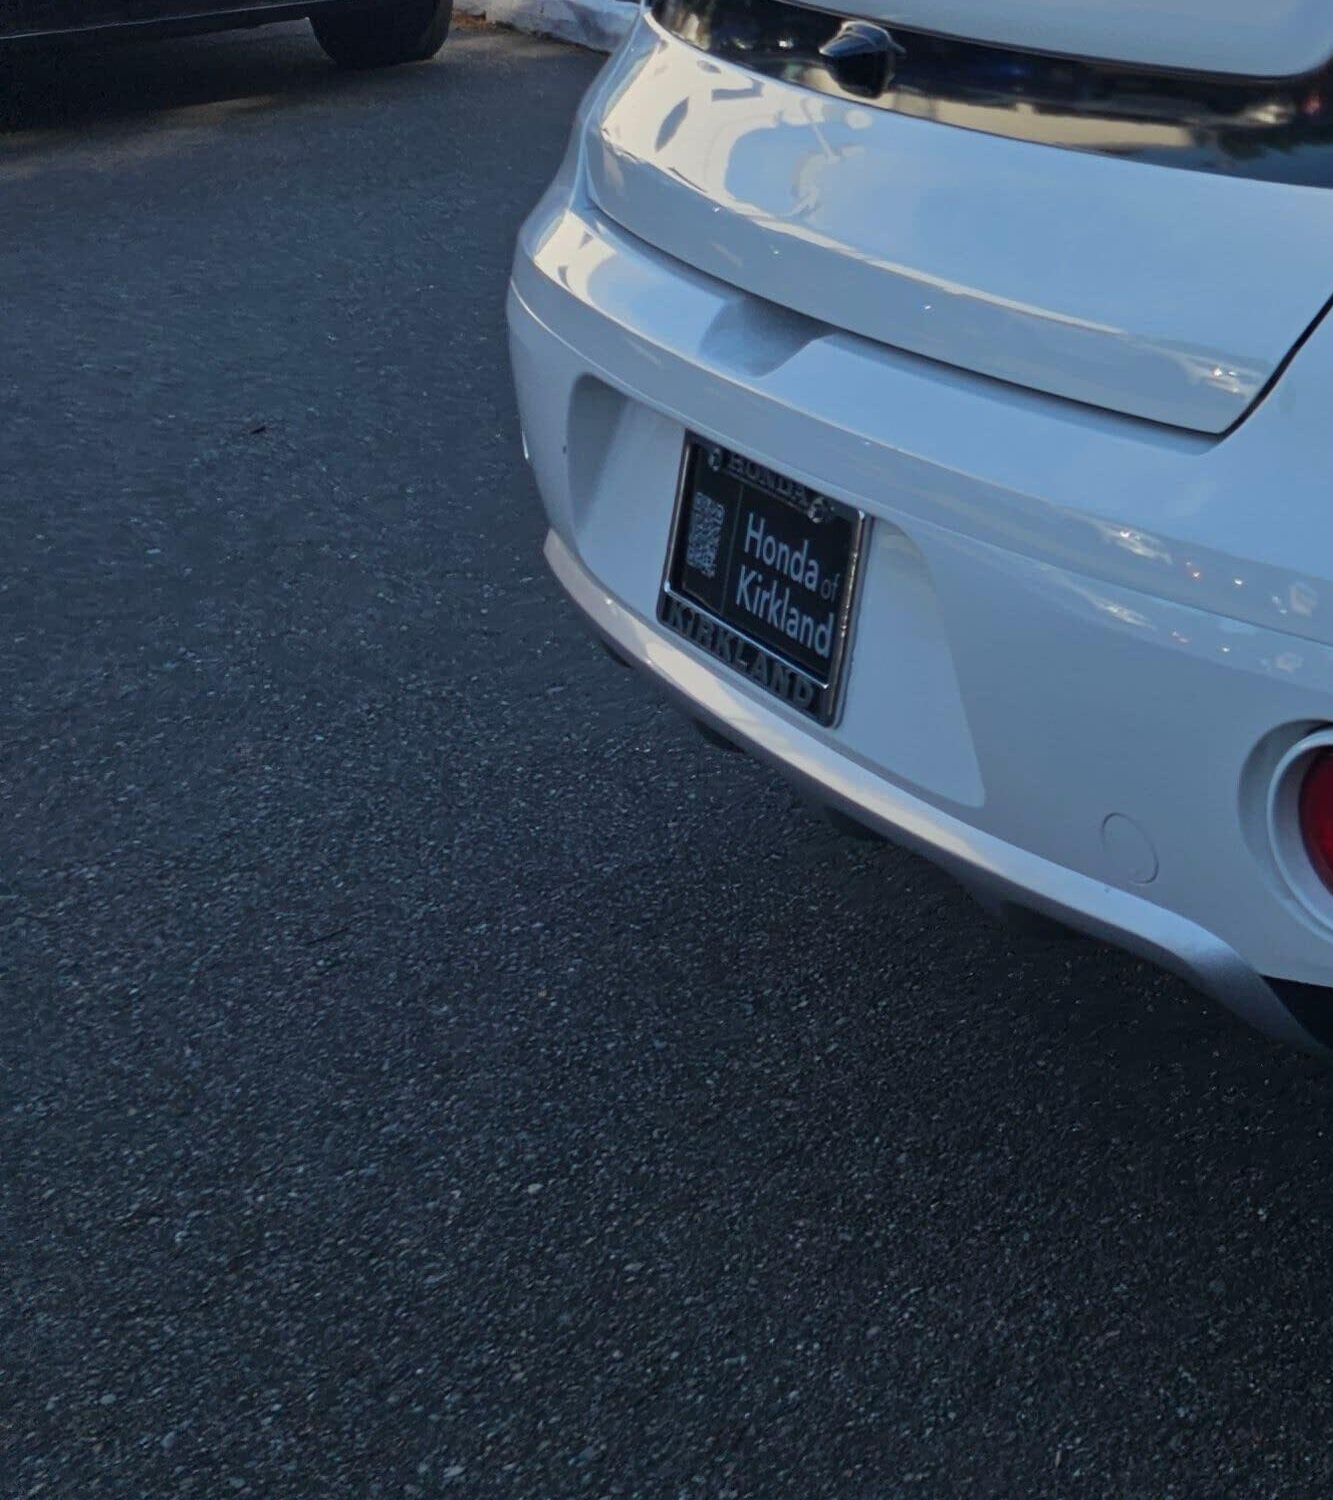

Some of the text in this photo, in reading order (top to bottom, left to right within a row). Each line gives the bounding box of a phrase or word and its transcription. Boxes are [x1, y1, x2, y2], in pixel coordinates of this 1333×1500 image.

[744, 512, 841, 601] Honda of
[667, 600, 814, 708] KIRKLAND
[736, 565, 834, 658] Kirkland
